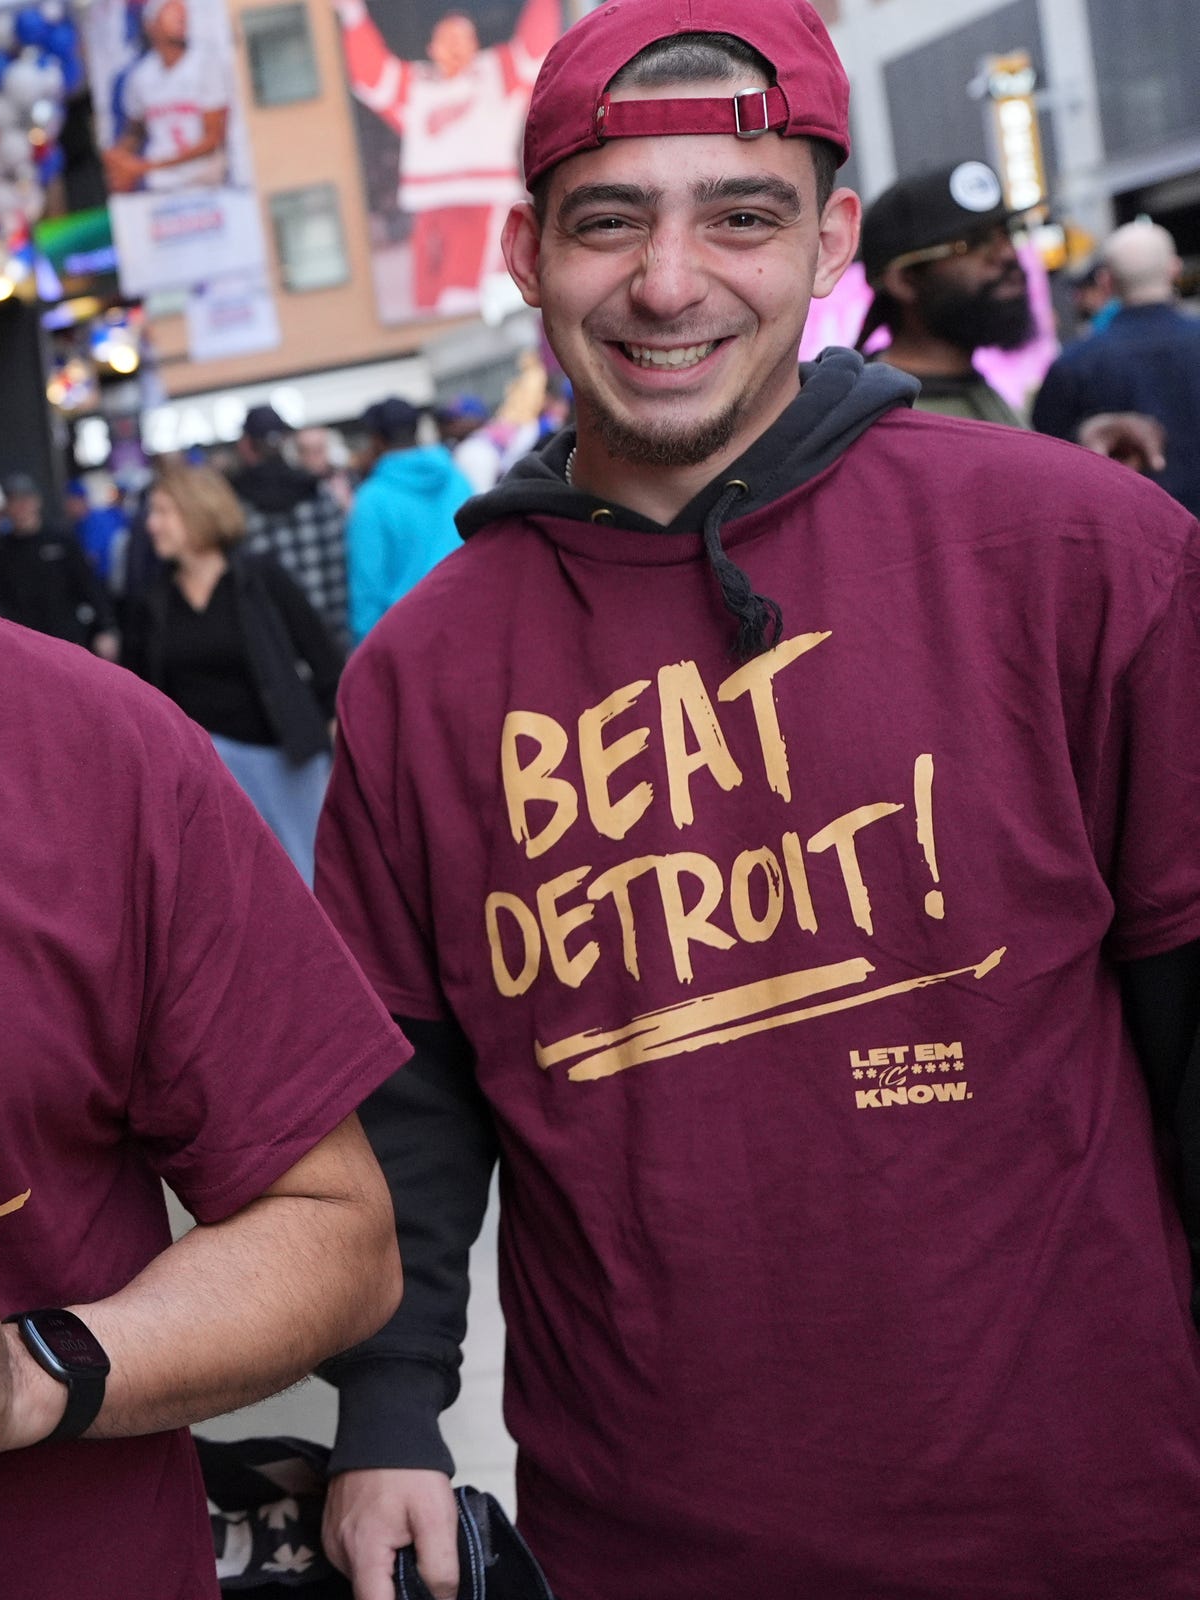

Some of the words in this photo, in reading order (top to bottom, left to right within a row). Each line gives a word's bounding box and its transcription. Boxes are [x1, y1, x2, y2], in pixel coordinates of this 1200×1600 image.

[501, 631, 832, 859] BEAT
[486, 753, 944, 997] DETROIT!
[849, 1045, 909, 1068] LET
[914, 1041, 963, 1061] EM
[855, 1082, 973, 1109] KNOW.
